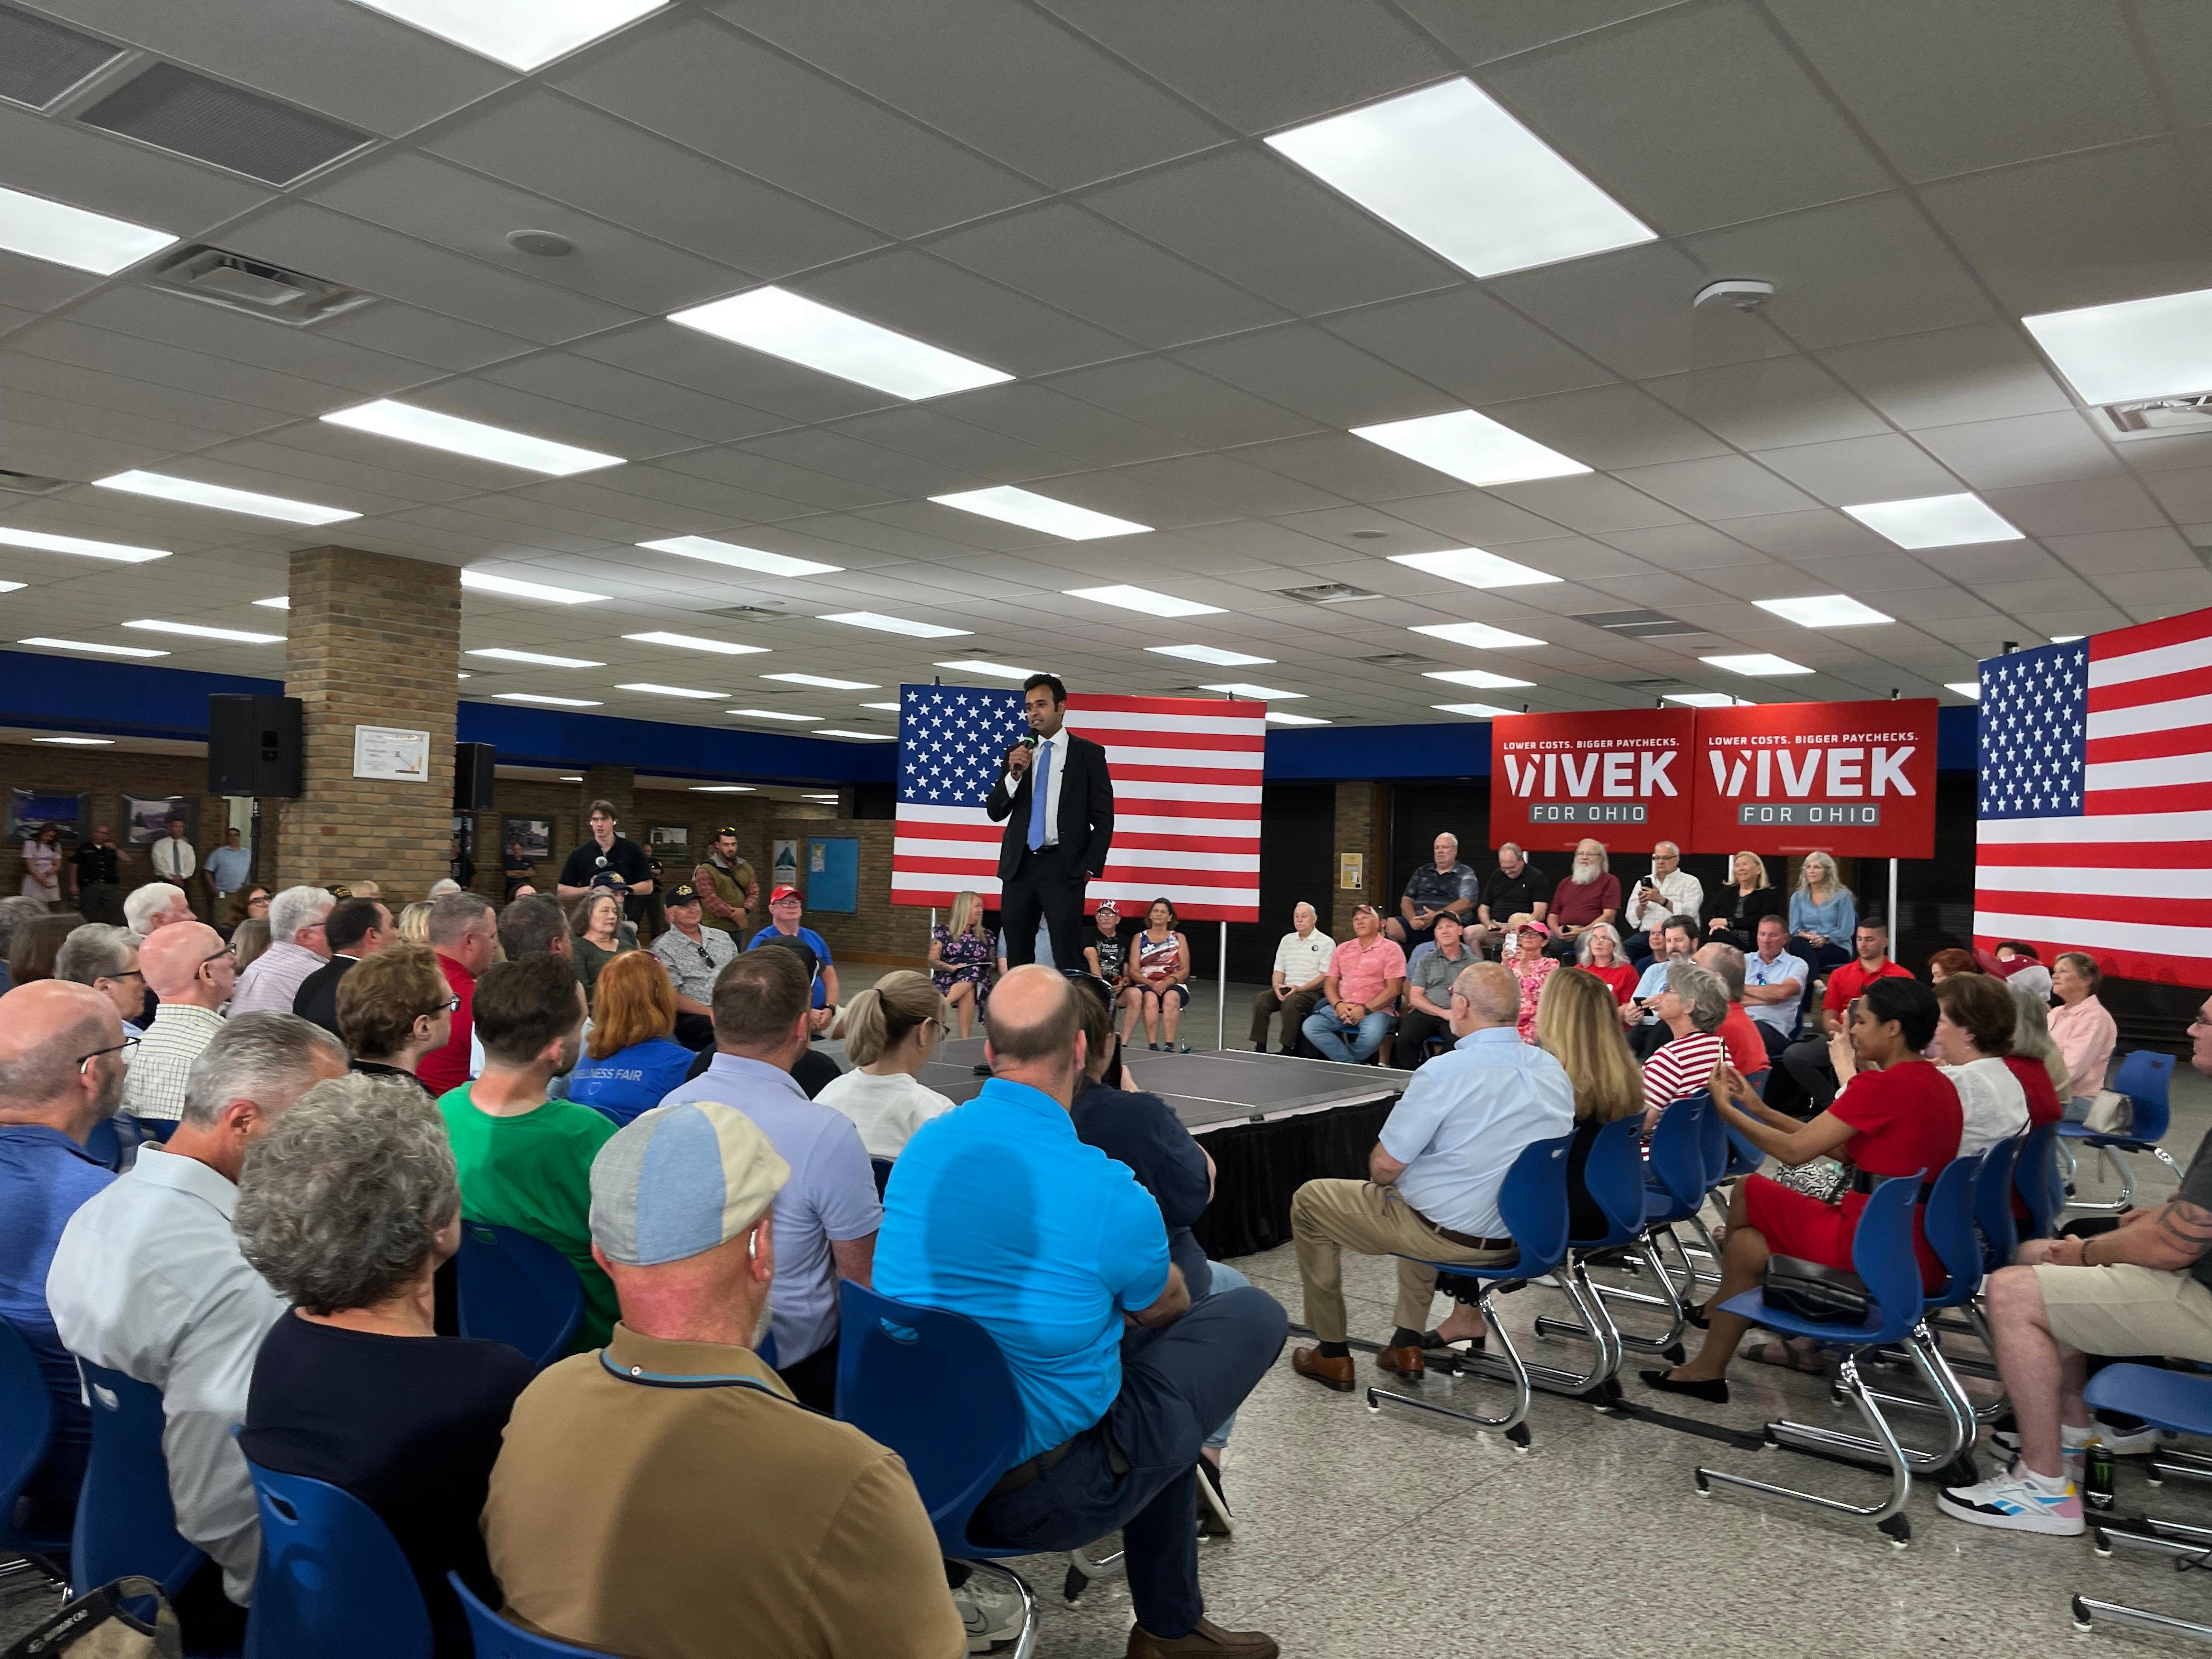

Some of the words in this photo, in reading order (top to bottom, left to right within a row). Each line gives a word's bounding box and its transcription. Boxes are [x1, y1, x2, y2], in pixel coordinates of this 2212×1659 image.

[1539, 741, 1573, 749] COSTS.
[1577, 740, 1613, 749] BIGGER
[1616, 737, 1680, 747] PAYCHECKS.
[1708, 736, 1747, 745] LOWER
[1751, 735, 1791, 745] COSTS.
[1795, 734, 1838, 744] BIGGER
[1842, 731, 1919, 743] PAYCHECKS.
[1503, 751, 1678, 797] VIVEK
[1708, 746, 1917, 797] VIVEK
[1534, 806, 1574, 820] FOR
[1589, 806, 1644, 821] OHIO
[1744, 807, 1792, 822] FOR
[1809, 807, 1875, 822] OHIO
[614, 1069, 642, 1081] FAIR
